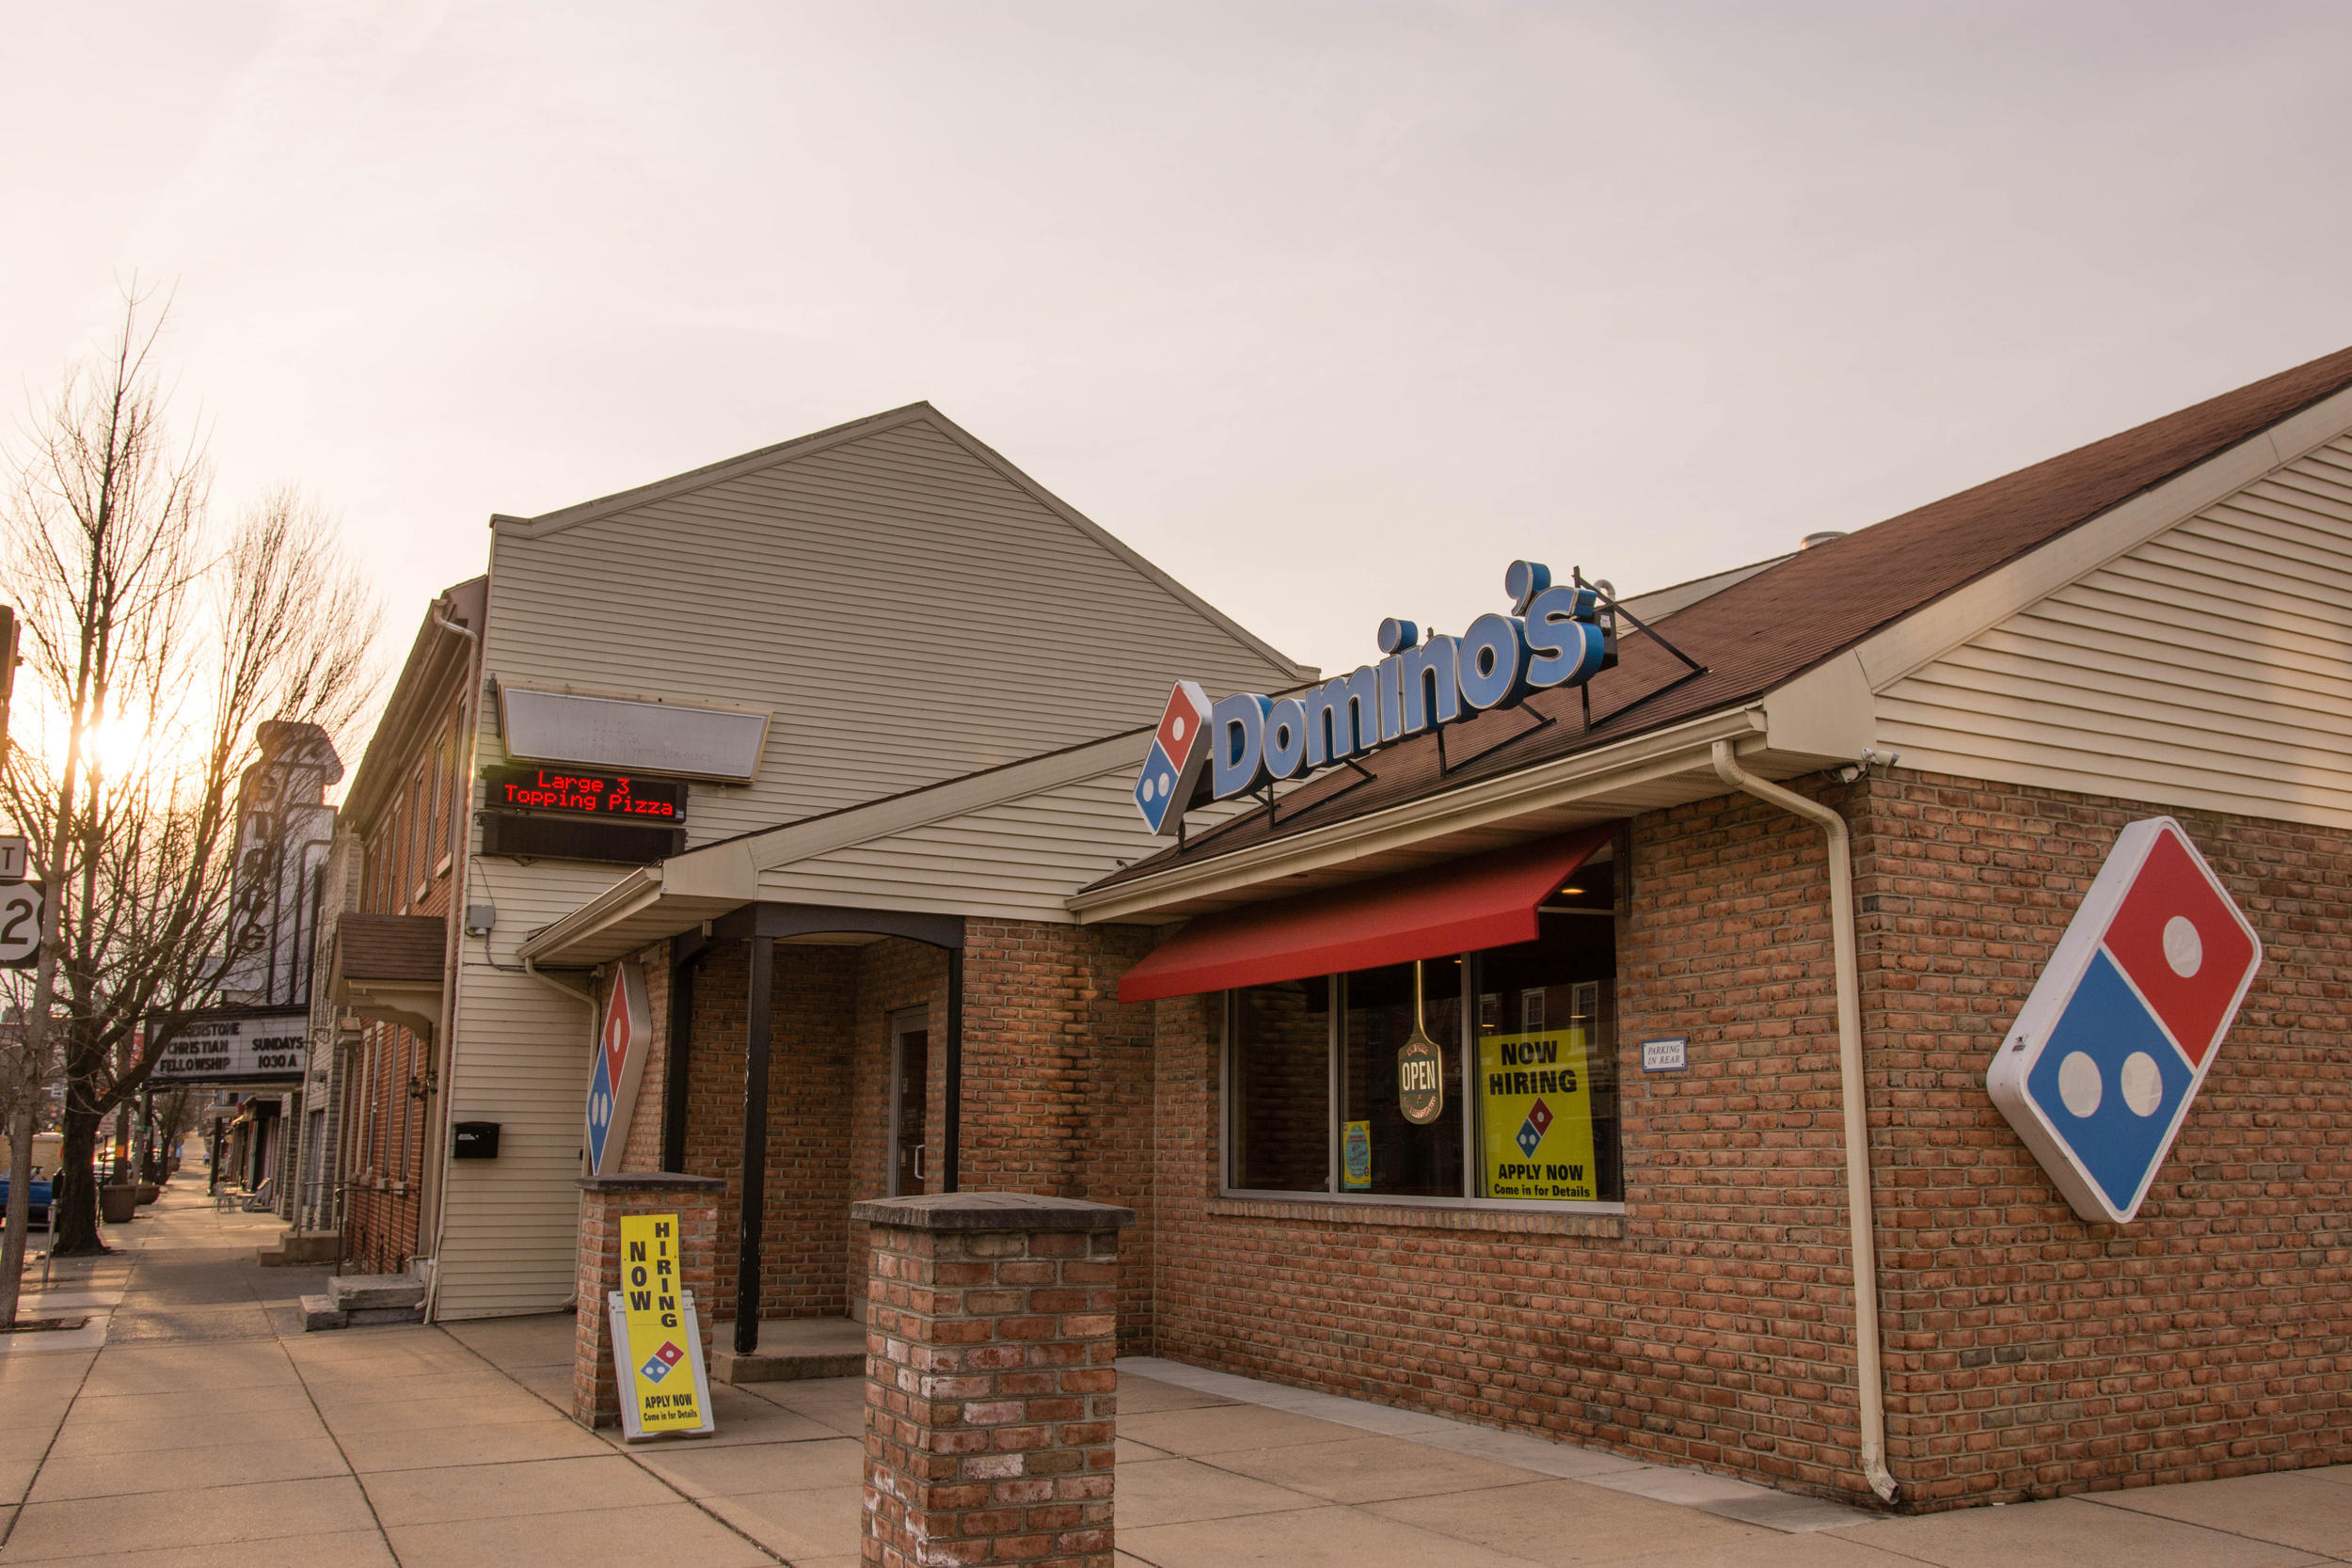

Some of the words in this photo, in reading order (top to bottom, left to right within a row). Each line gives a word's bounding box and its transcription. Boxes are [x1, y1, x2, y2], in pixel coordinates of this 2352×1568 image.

[1212, 559, 1605, 800] Domino's
[538, 770, 604, 793] Large
[617, 778, 630, 795] 3
[504, 784, 596, 811] Topping
[610, 794, 674, 816] Pizza
[167, 1039, 230, 1054] CHRISTIAN
[252, 1036, 304, 1051] SUNDAYS
[1647, 1045, 1680, 1054] PARKING
[1501, 1040, 1558, 1066] NOW
[1647, 1056, 1657, 1065] IN
[1660, 1055, 1680, 1064] REAR
[159, 1056, 231, 1072] FELLOWSHIP
[258, 1054, 286, 1069] 1030
[1402, 1060, 1436, 1091] OPEN
[1489, 1069, 1578, 1096] HIRING
[1499, 1164, 1541, 1180] APPLY
[1547, 1164, 1583, 1180] NOW
[1494, 1183, 1519, 1196] Come
[1522, 1185, 1532, 1196] in
[1534, 1184, 1549, 1196] for
[1552, 1185, 1590, 1197] Details
[629, 1241, 651, 1311] NOW
[655, 1222, 678, 1328] HIRING
[645, 1395, 671, 1409] APPLY
[673, 1393, 692, 1406] NOW
[644, 1410, 660, 1421] Come
[660, 1411, 667, 1420] in
[668, 1409, 676, 1419] for
[677, 1406, 698, 1418] Details
